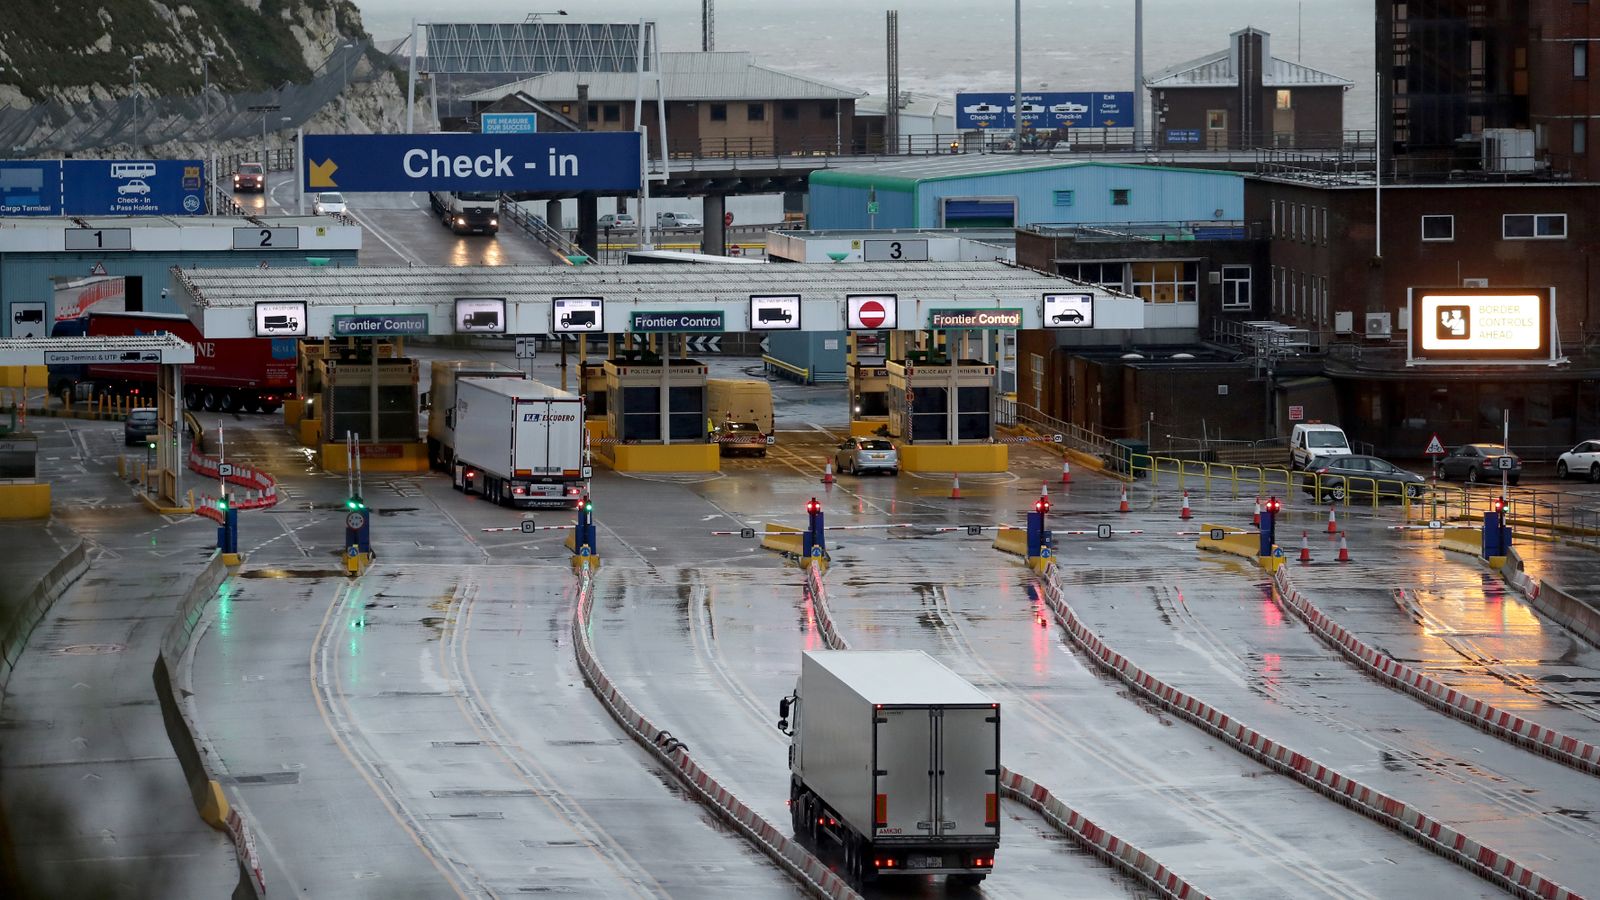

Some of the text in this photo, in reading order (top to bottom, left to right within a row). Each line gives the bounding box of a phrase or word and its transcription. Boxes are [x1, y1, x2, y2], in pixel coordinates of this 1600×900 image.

[403, 149, 514, 178] Check
[549, 148, 578, 176] in
[94, 231, 102, 248] 1
[260, 230, 272, 246] 2
[890, 242, 902, 259] 3
[1479, 306, 1520, 314] BORDER
[338, 320, 424, 330] Frontier Control
[635, 316, 720, 327] Frontier Control
[934, 314, 1019, 324] Frontier Control
[1479, 318, 1533, 326] CONTROLS
[196, 342, 216, 358] NE
